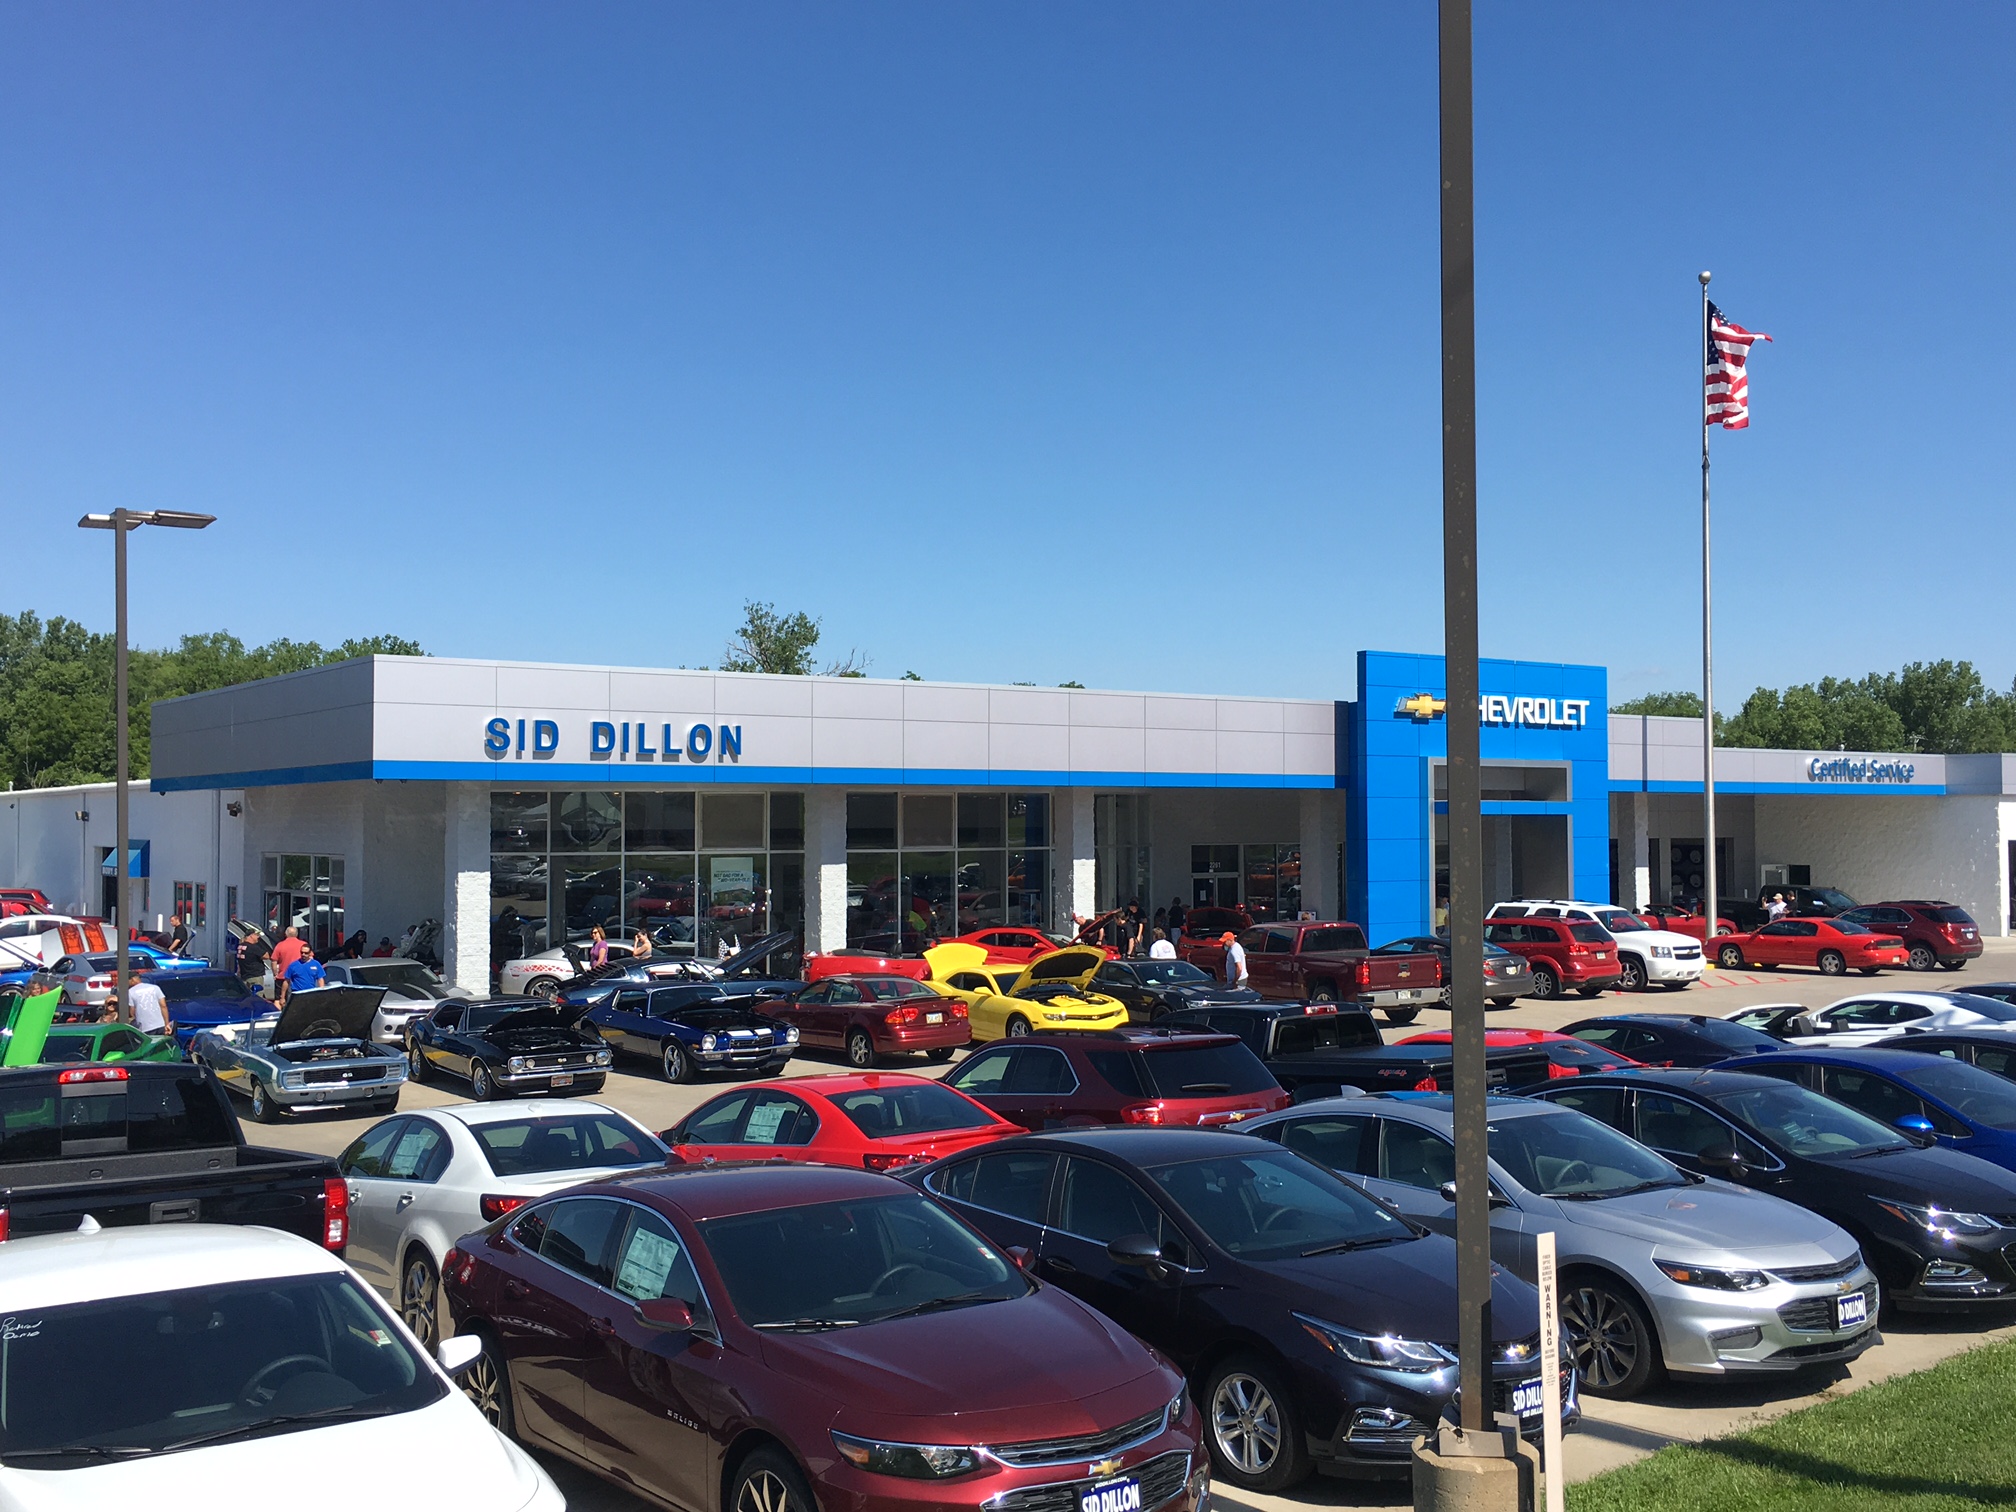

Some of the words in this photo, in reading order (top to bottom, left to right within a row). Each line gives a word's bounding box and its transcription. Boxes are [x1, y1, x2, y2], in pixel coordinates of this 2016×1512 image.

[1478, 695, 1590, 725] HEVROLET
[486, 717, 559, 752] SID
[591, 721, 742, 756] DILLON
[1810, 757, 1866, 778] Certified
[1870, 759, 1915, 779] Service
[1544, 1284, 1552, 1346] WARNING
[1844, 1299, 1864, 1320] DILLON
[1513, 1390, 1525, 1411] SID
[1526, 1385, 1543, 1408] DILL
[667, 1409, 699, 1430] MALIBU
[1082, 1494, 1101, 1512] SID
[1101, 1484, 1140, 1512] DILLON
